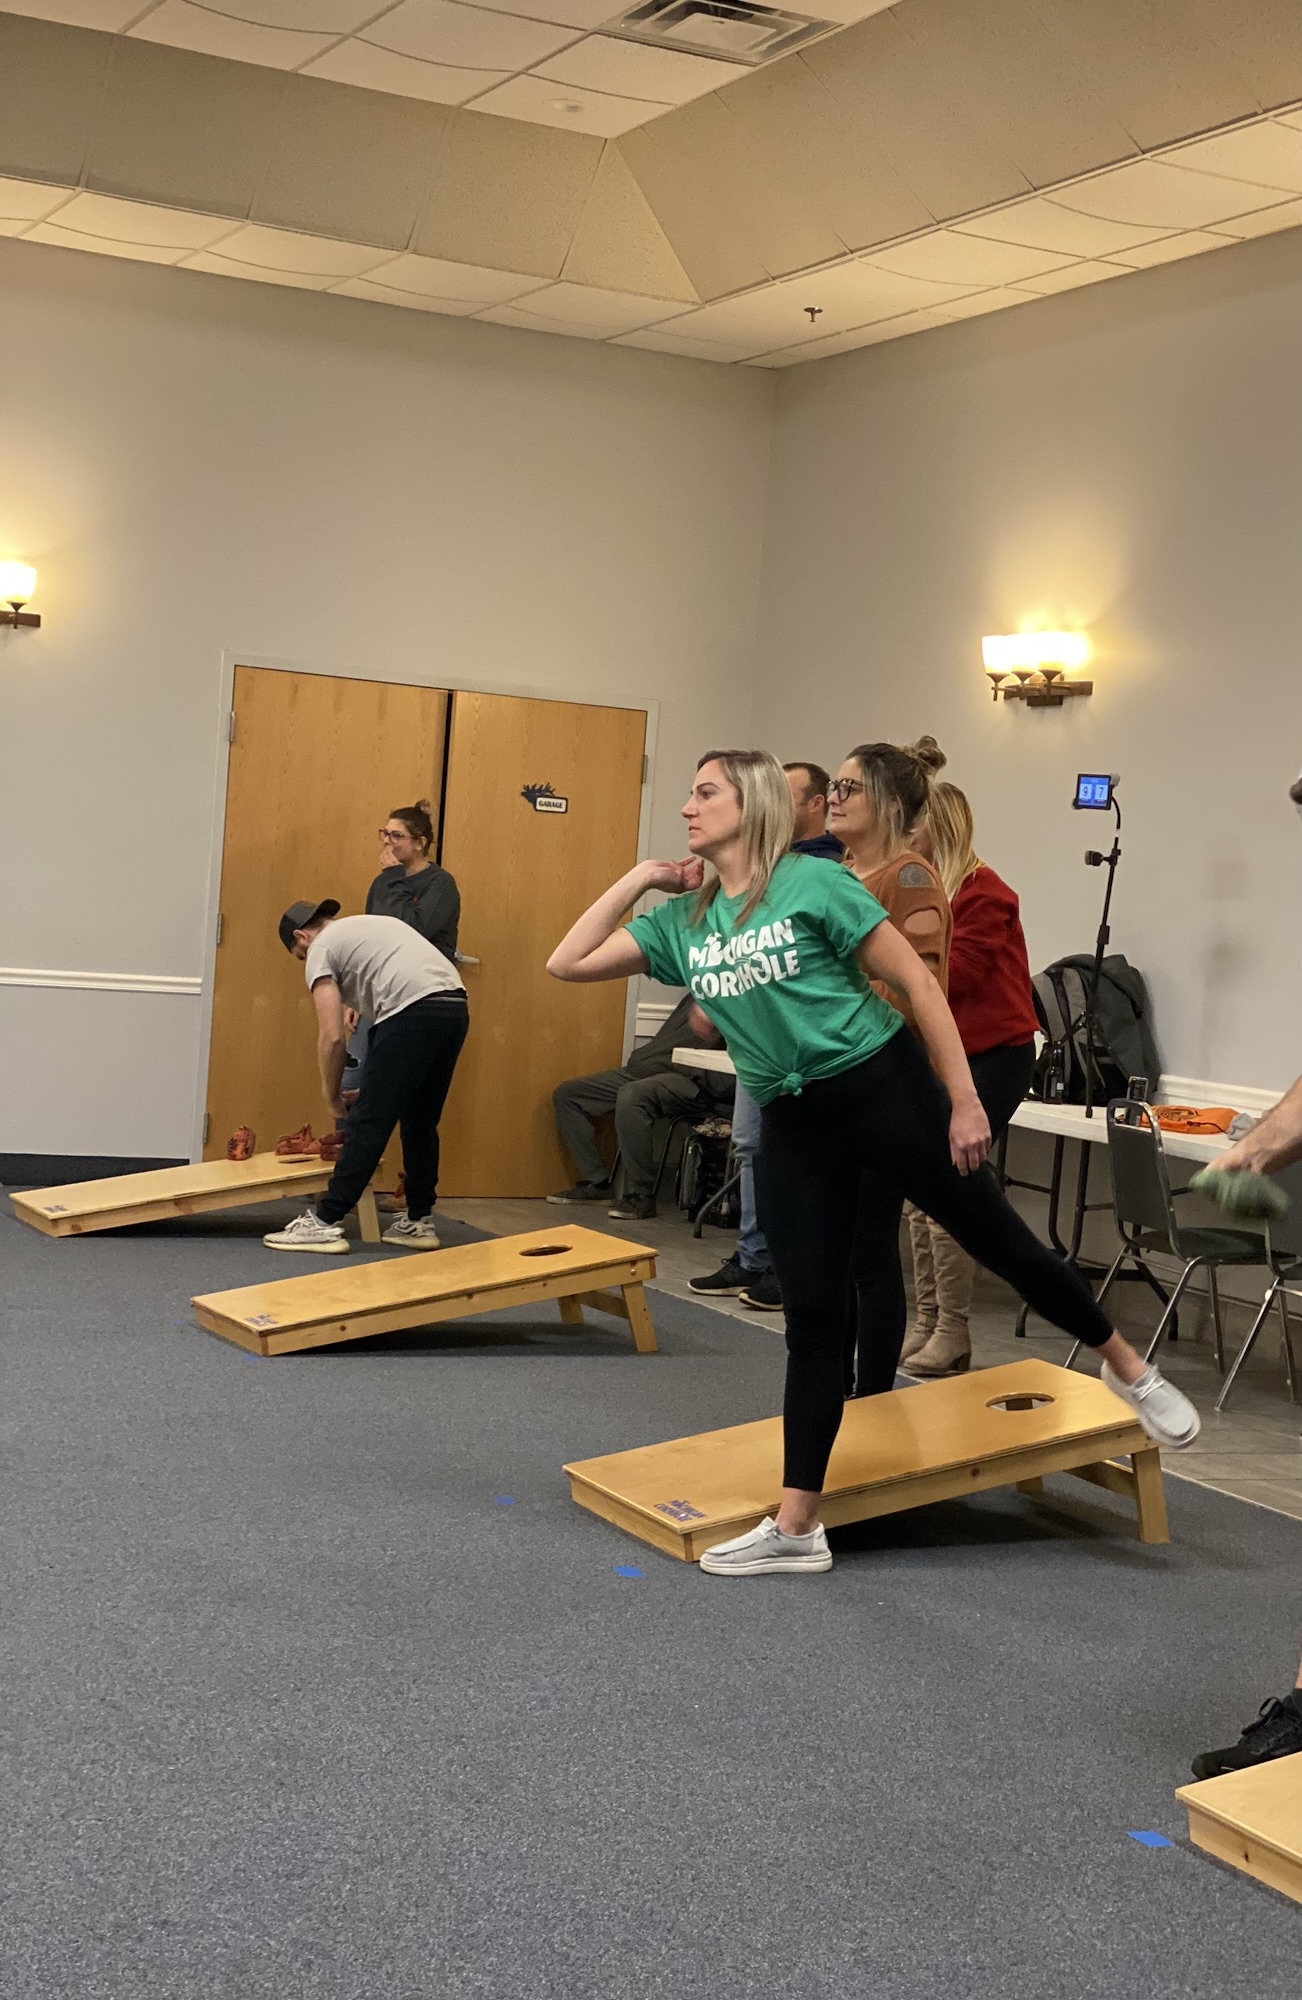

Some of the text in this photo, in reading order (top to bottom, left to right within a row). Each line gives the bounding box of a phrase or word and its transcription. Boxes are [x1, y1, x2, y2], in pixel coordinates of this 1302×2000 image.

[1083, 786, 1104, 798] 9 7
[538, 800, 563, 808] GARAGE
